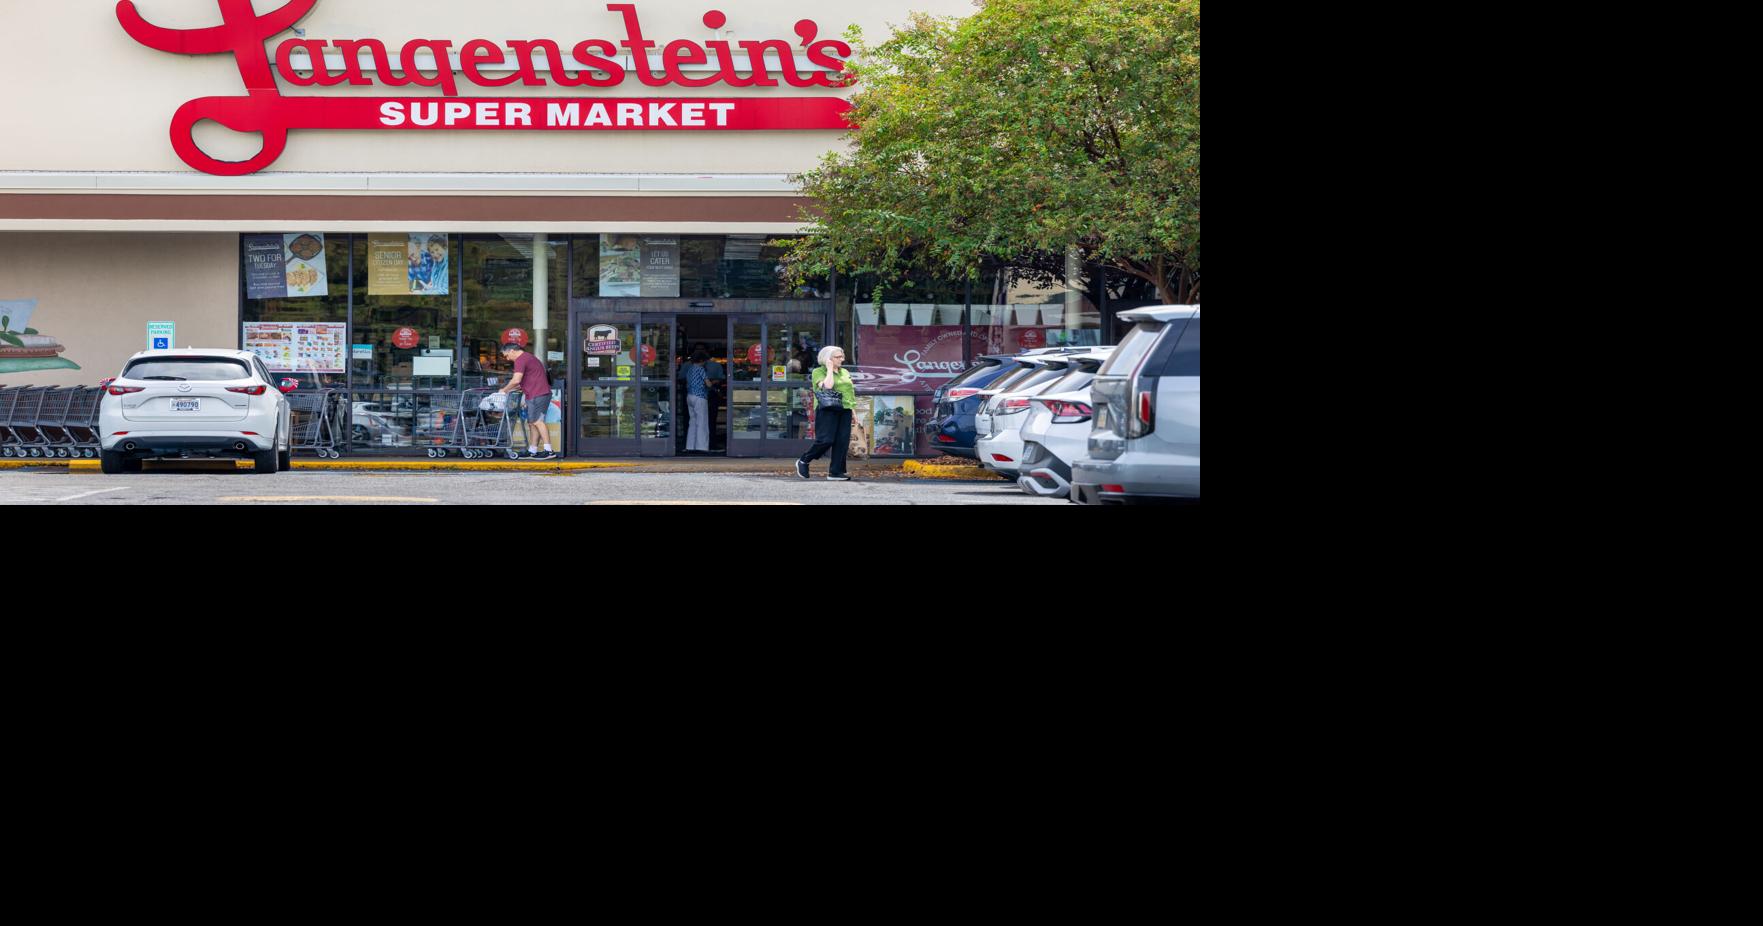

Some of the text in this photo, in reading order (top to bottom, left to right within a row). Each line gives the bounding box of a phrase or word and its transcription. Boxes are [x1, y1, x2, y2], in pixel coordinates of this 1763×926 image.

[116, 0, 858, 176] Langenstein's
[379, 101, 735, 126] SUPER MARKET
[248, 253, 282, 263] TWO FOR
[374, 251, 402, 260] SENIOR
[650, 257, 670, 265] CATER
